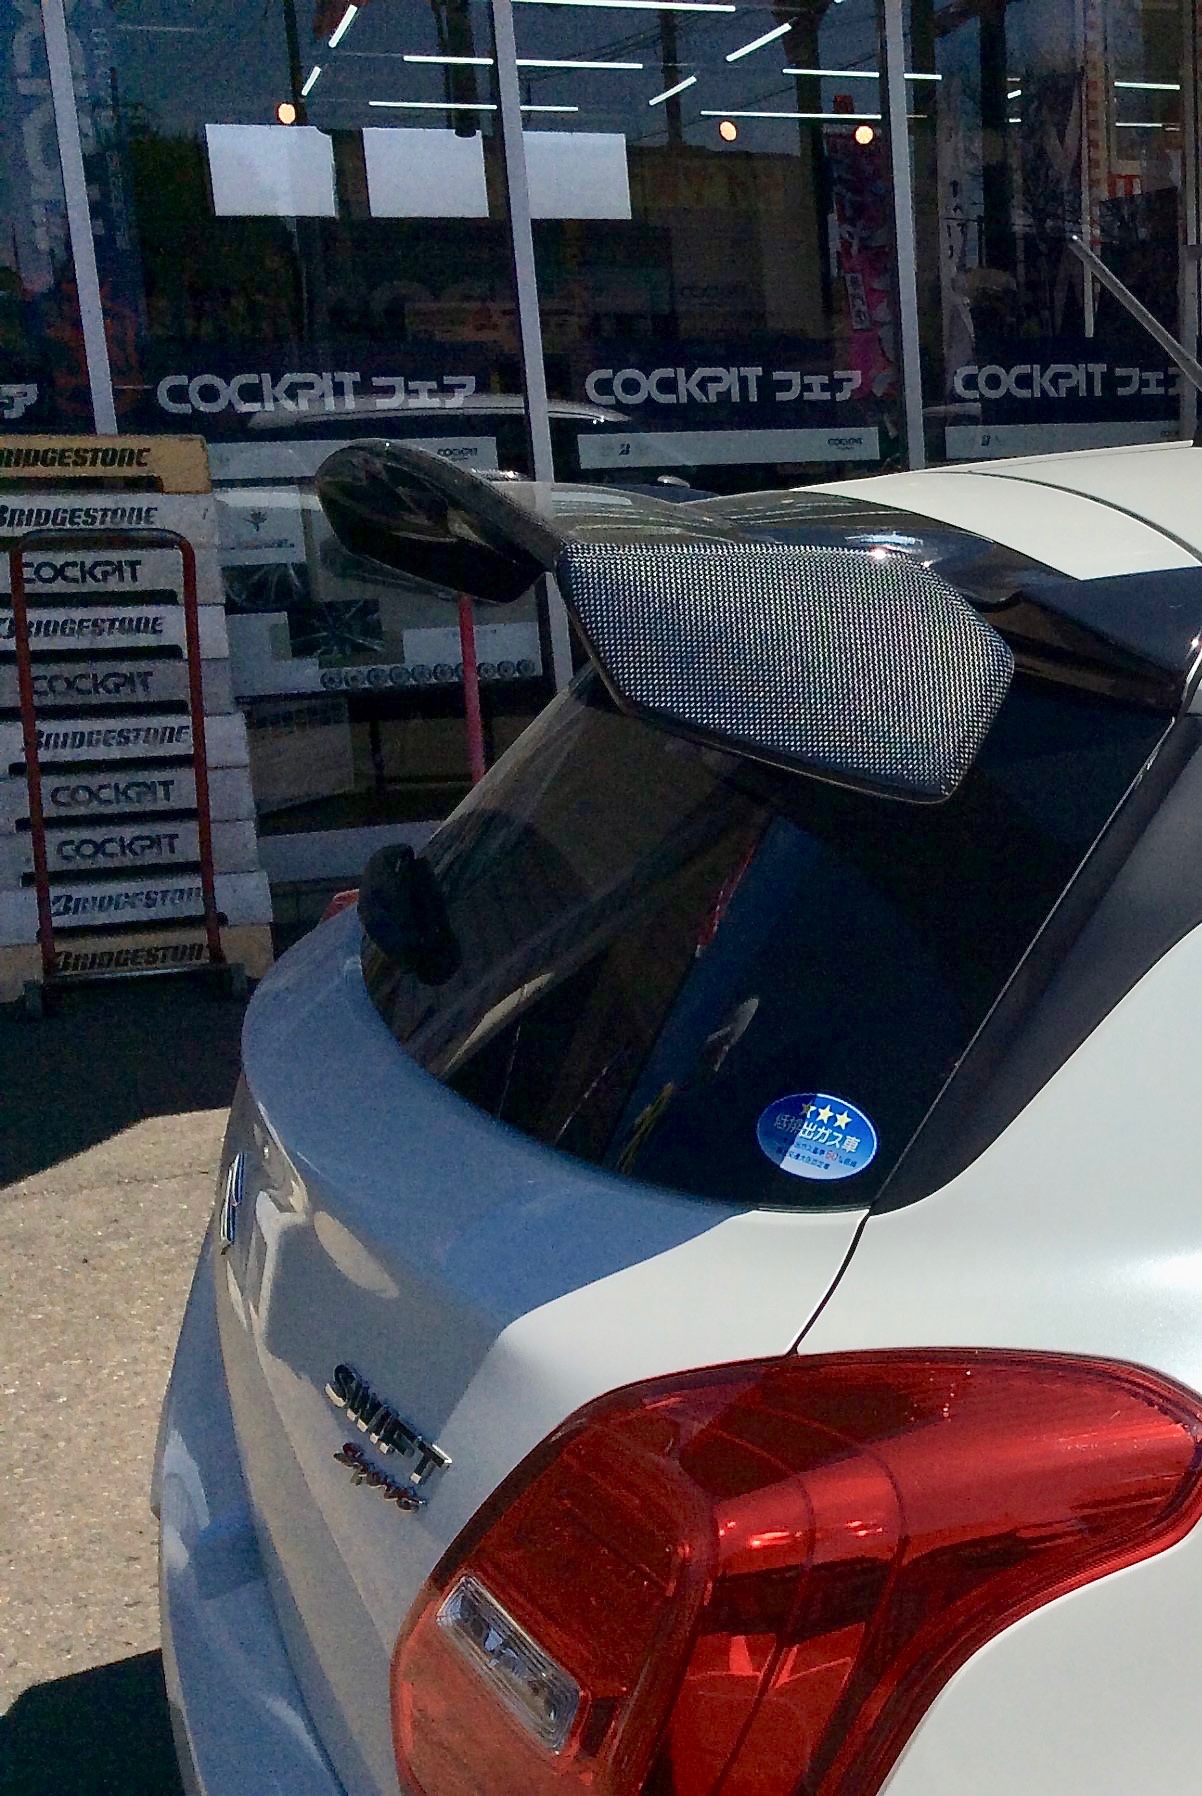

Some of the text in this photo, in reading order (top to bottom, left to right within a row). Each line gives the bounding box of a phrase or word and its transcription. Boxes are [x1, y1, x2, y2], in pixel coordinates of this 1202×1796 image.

[156, 371, 361, 414] COCKPIT
[584, 366, 862, 405] COCKPIT フェア
[952, 363, 1107, 399] COCKPIT
[0, 448, 151, 468] RIDGESTONE
[50, 779, 174, 807] COCKPIT
[56, 833, 179, 861] COCKPIT
[51, 887, 202, 917] BRIDGESTON
[52, 943, 210, 972] BRIDGESTON
[774, 1112, 861, 1153] 低排出ガス車
[324, 1364, 453, 1485] SWIFT
